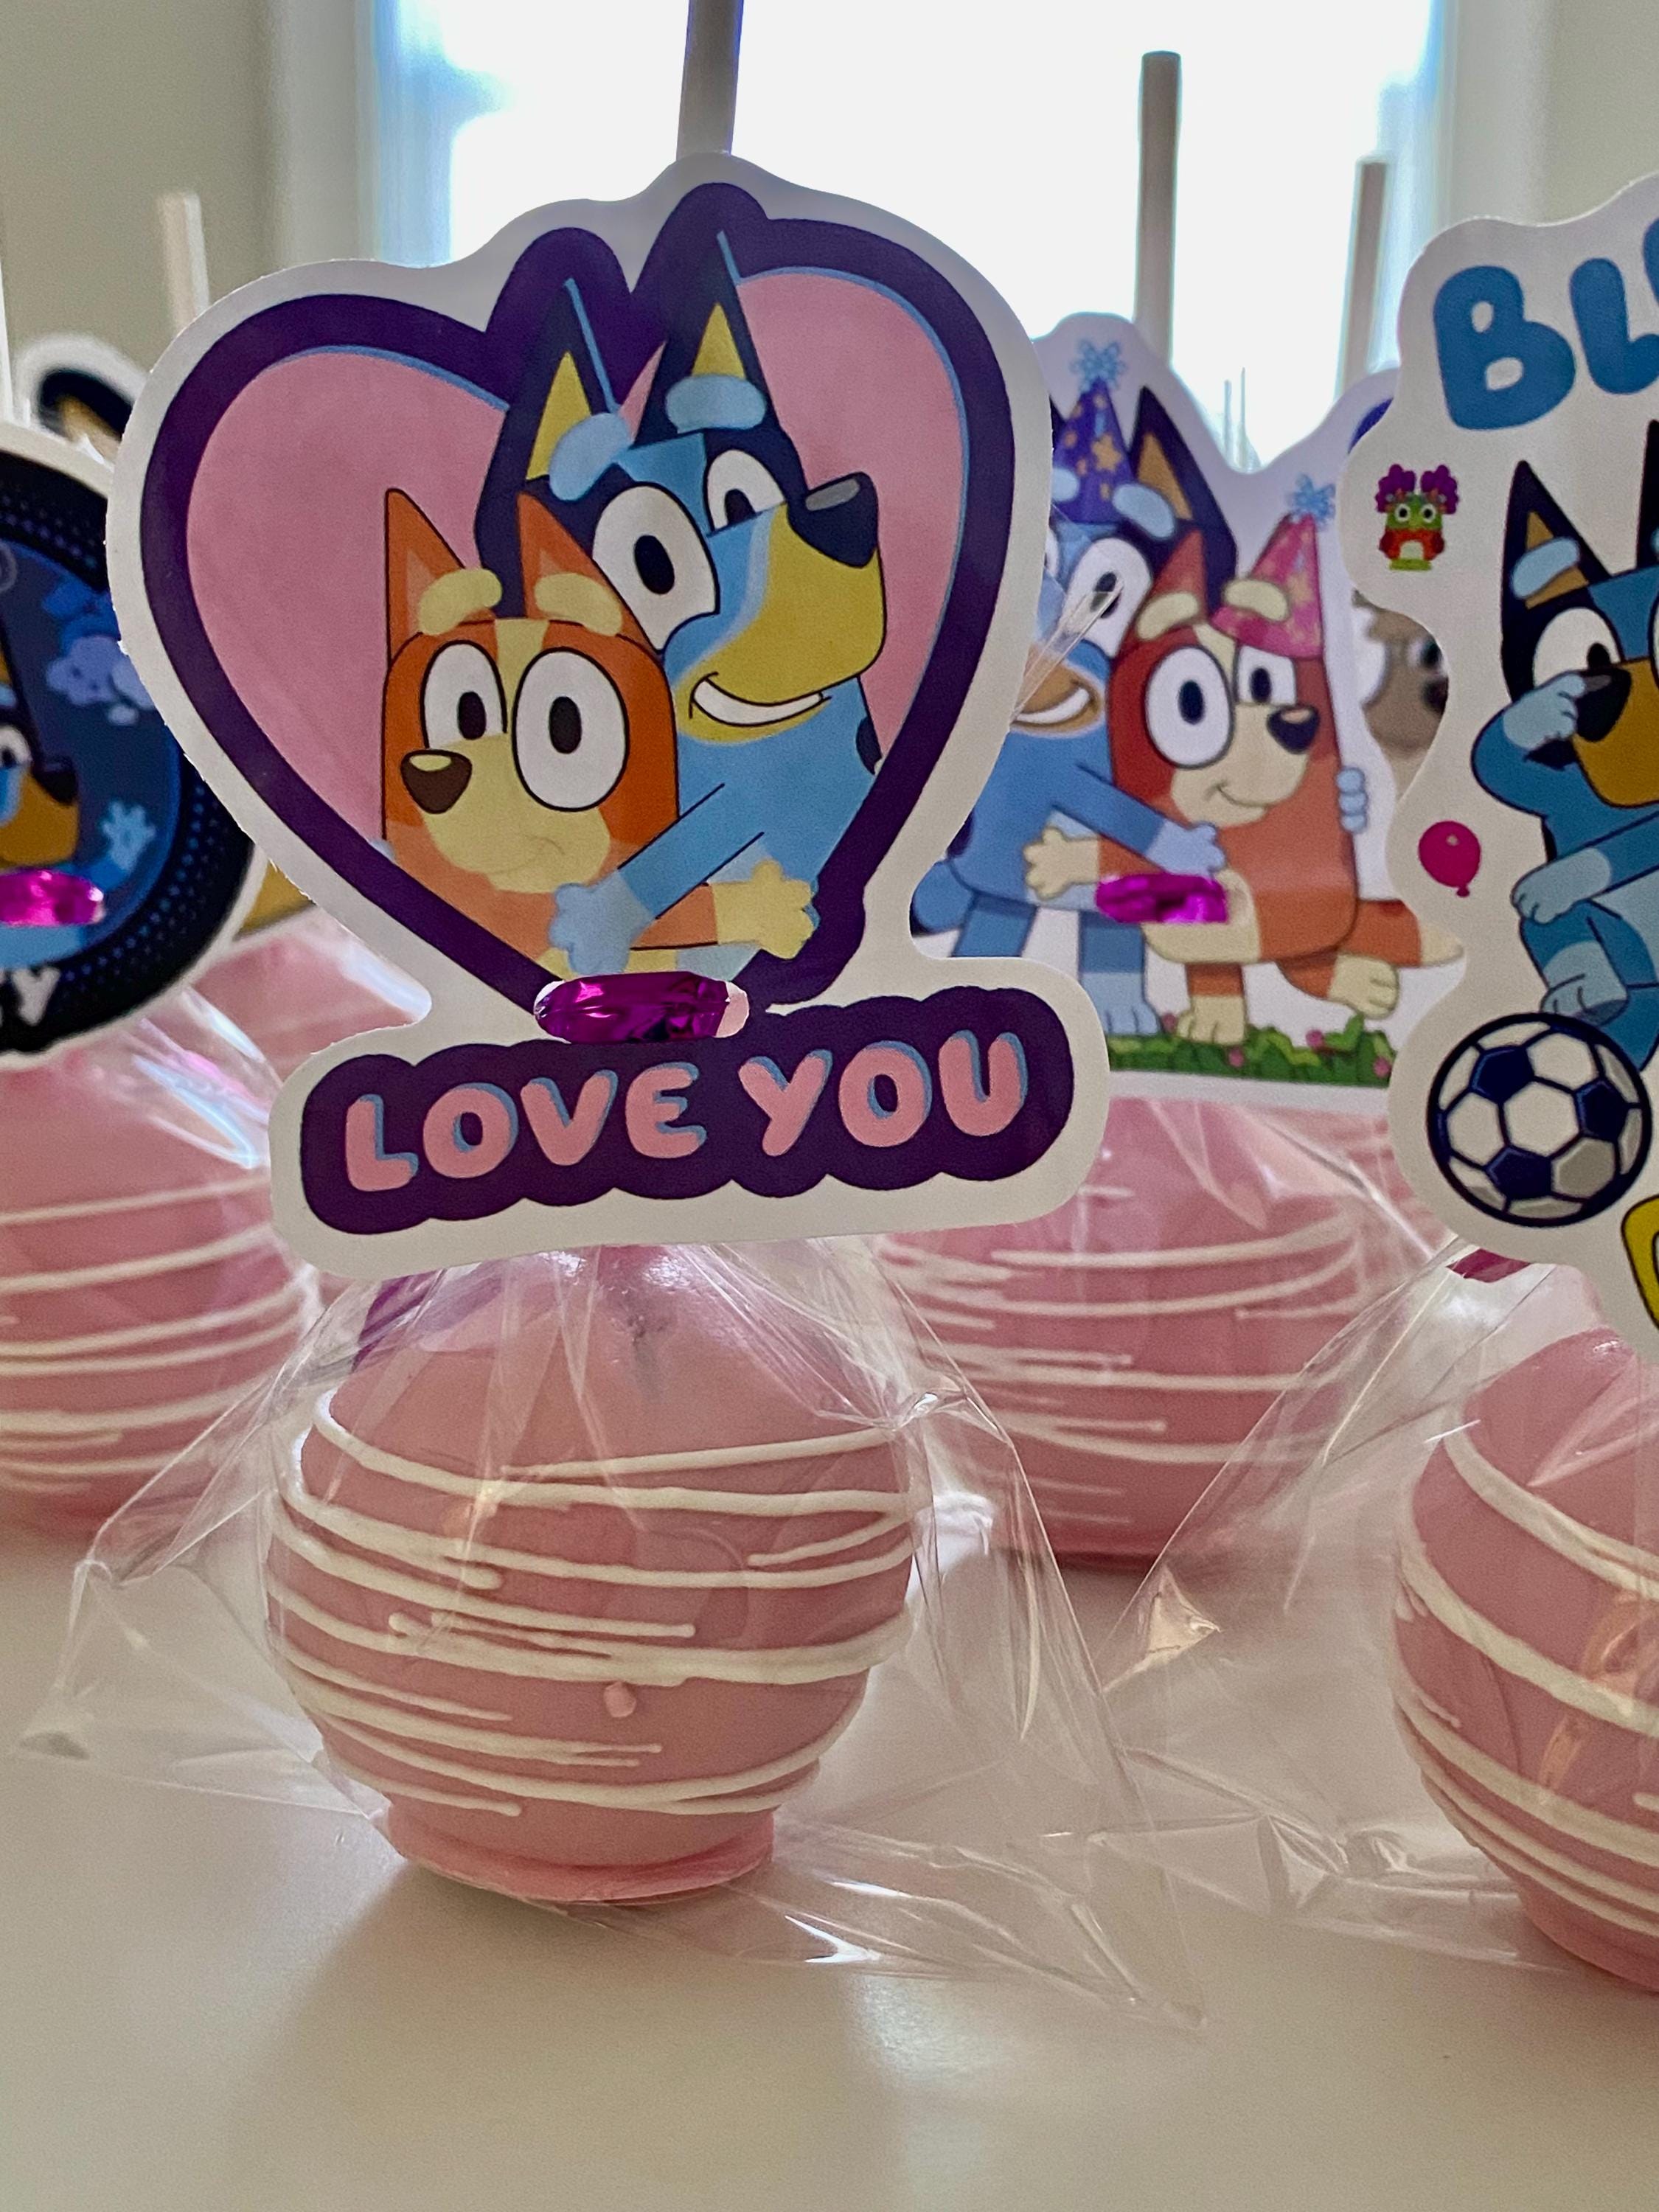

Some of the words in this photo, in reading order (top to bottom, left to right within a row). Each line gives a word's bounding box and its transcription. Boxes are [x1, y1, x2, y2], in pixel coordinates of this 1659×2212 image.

[1433, 217, 1659, 431] BL
[345, 1062, 706, 1192] LOVE
[738, 1030, 1028, 1157] YOU
